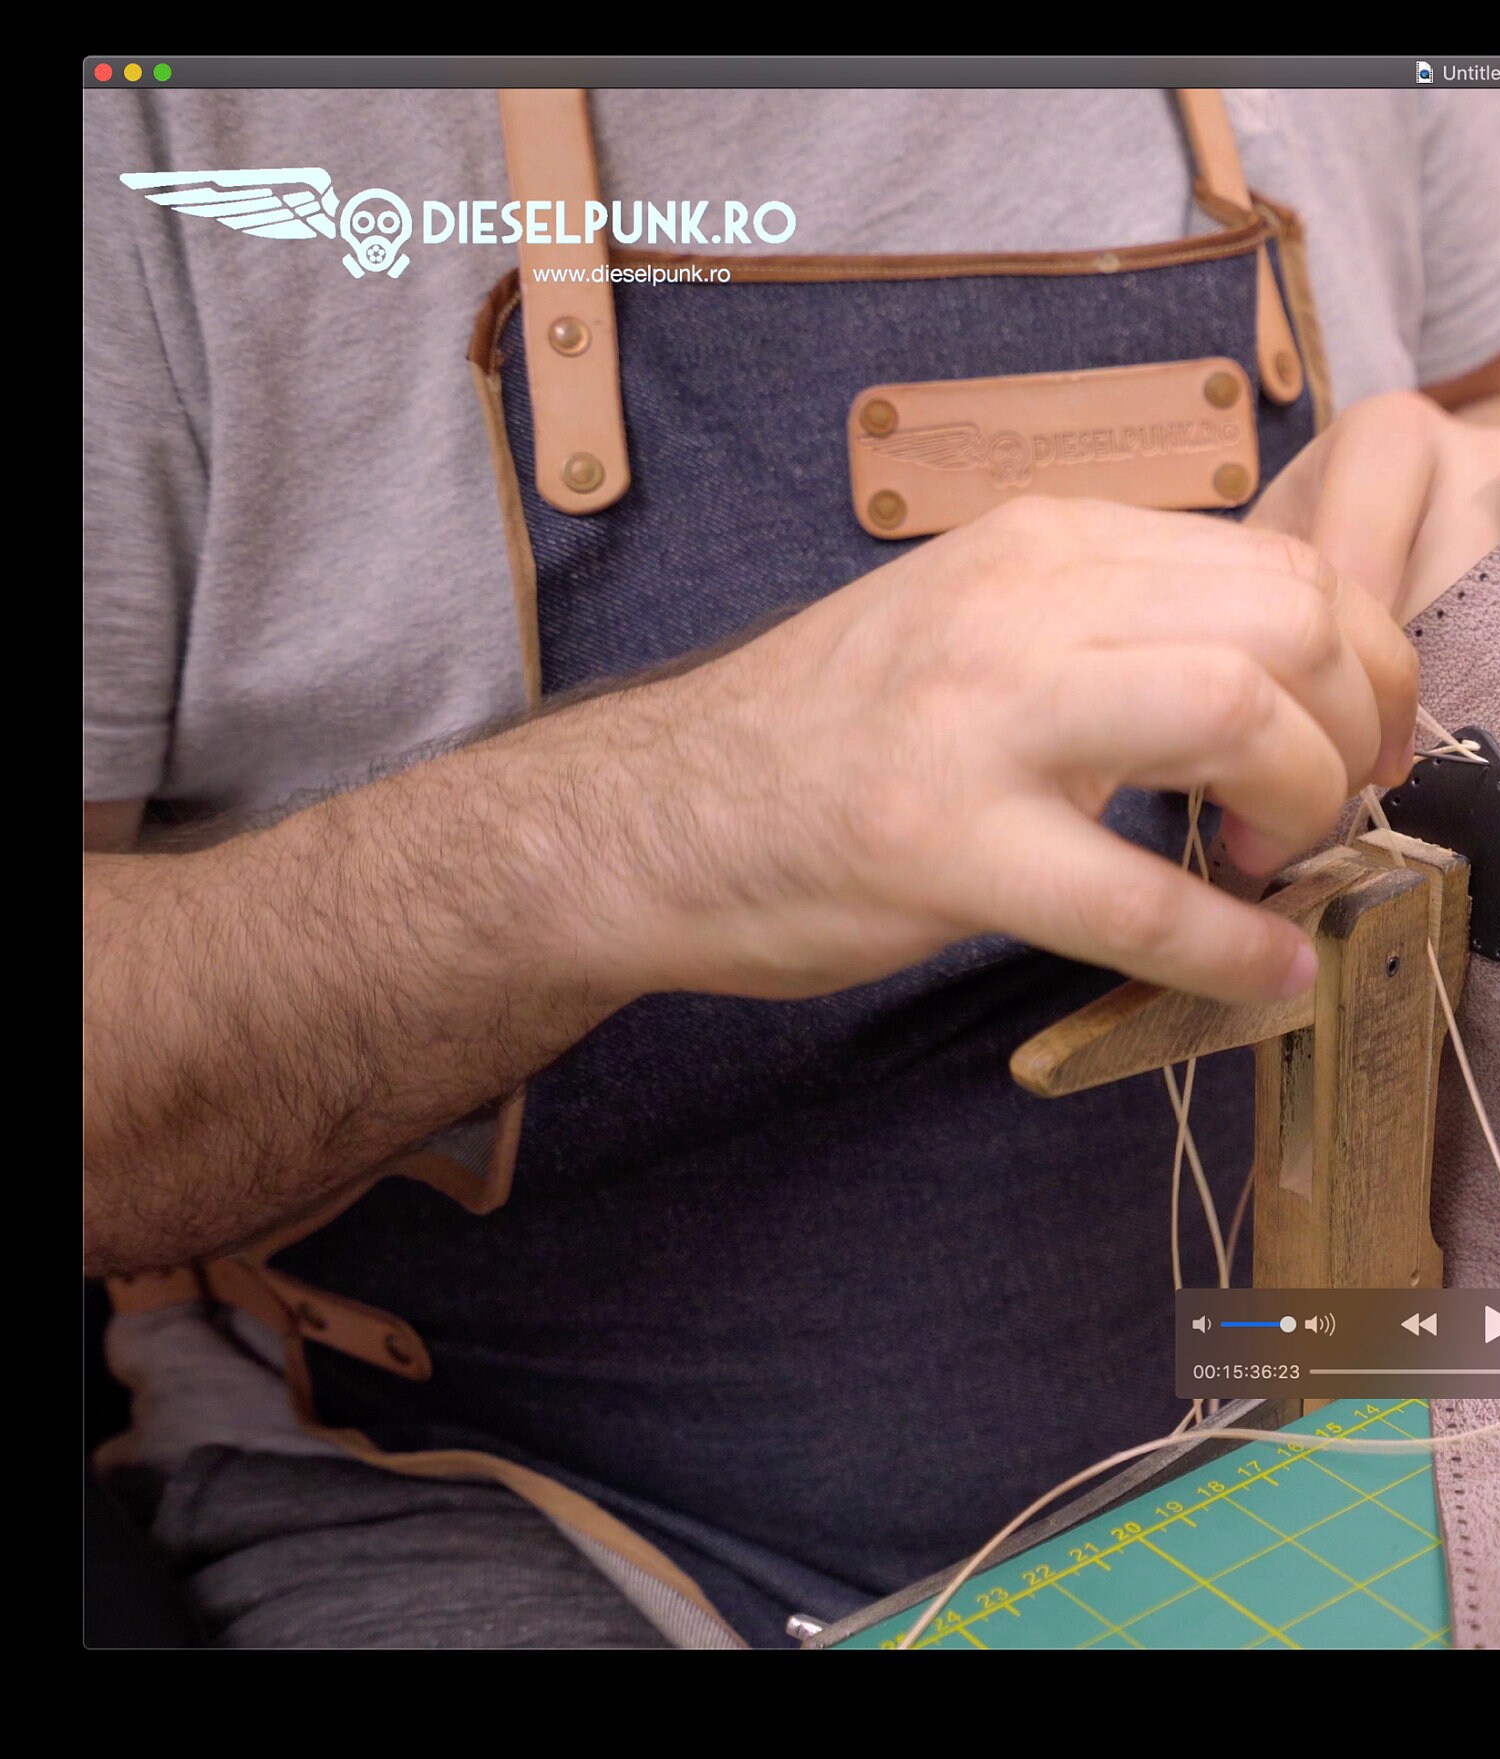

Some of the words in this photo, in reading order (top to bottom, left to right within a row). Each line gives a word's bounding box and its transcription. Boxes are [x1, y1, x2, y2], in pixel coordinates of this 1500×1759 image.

[1193, 1364, 1301, 1380] 00:15:36:23
[1354, 1404, 1381, 1419] 14
[1315, 1422, 1343, 1438] 15
[1277, 1442, 1304, 1457] 16
[1237, 1460, 1263, 1477] 17
[1196, 1480, 1225, 1498] 18
[1155, 1501, 1184, 1518] 19
[1110, 1521, 1142, 1542] 20
[1069, 1542, 1100, 1562] 21
[1022, 1564, 1056, 1587] 22
[976, 1587, 1009, 1609] 23
[934, 1610, 961, 1634] 24
